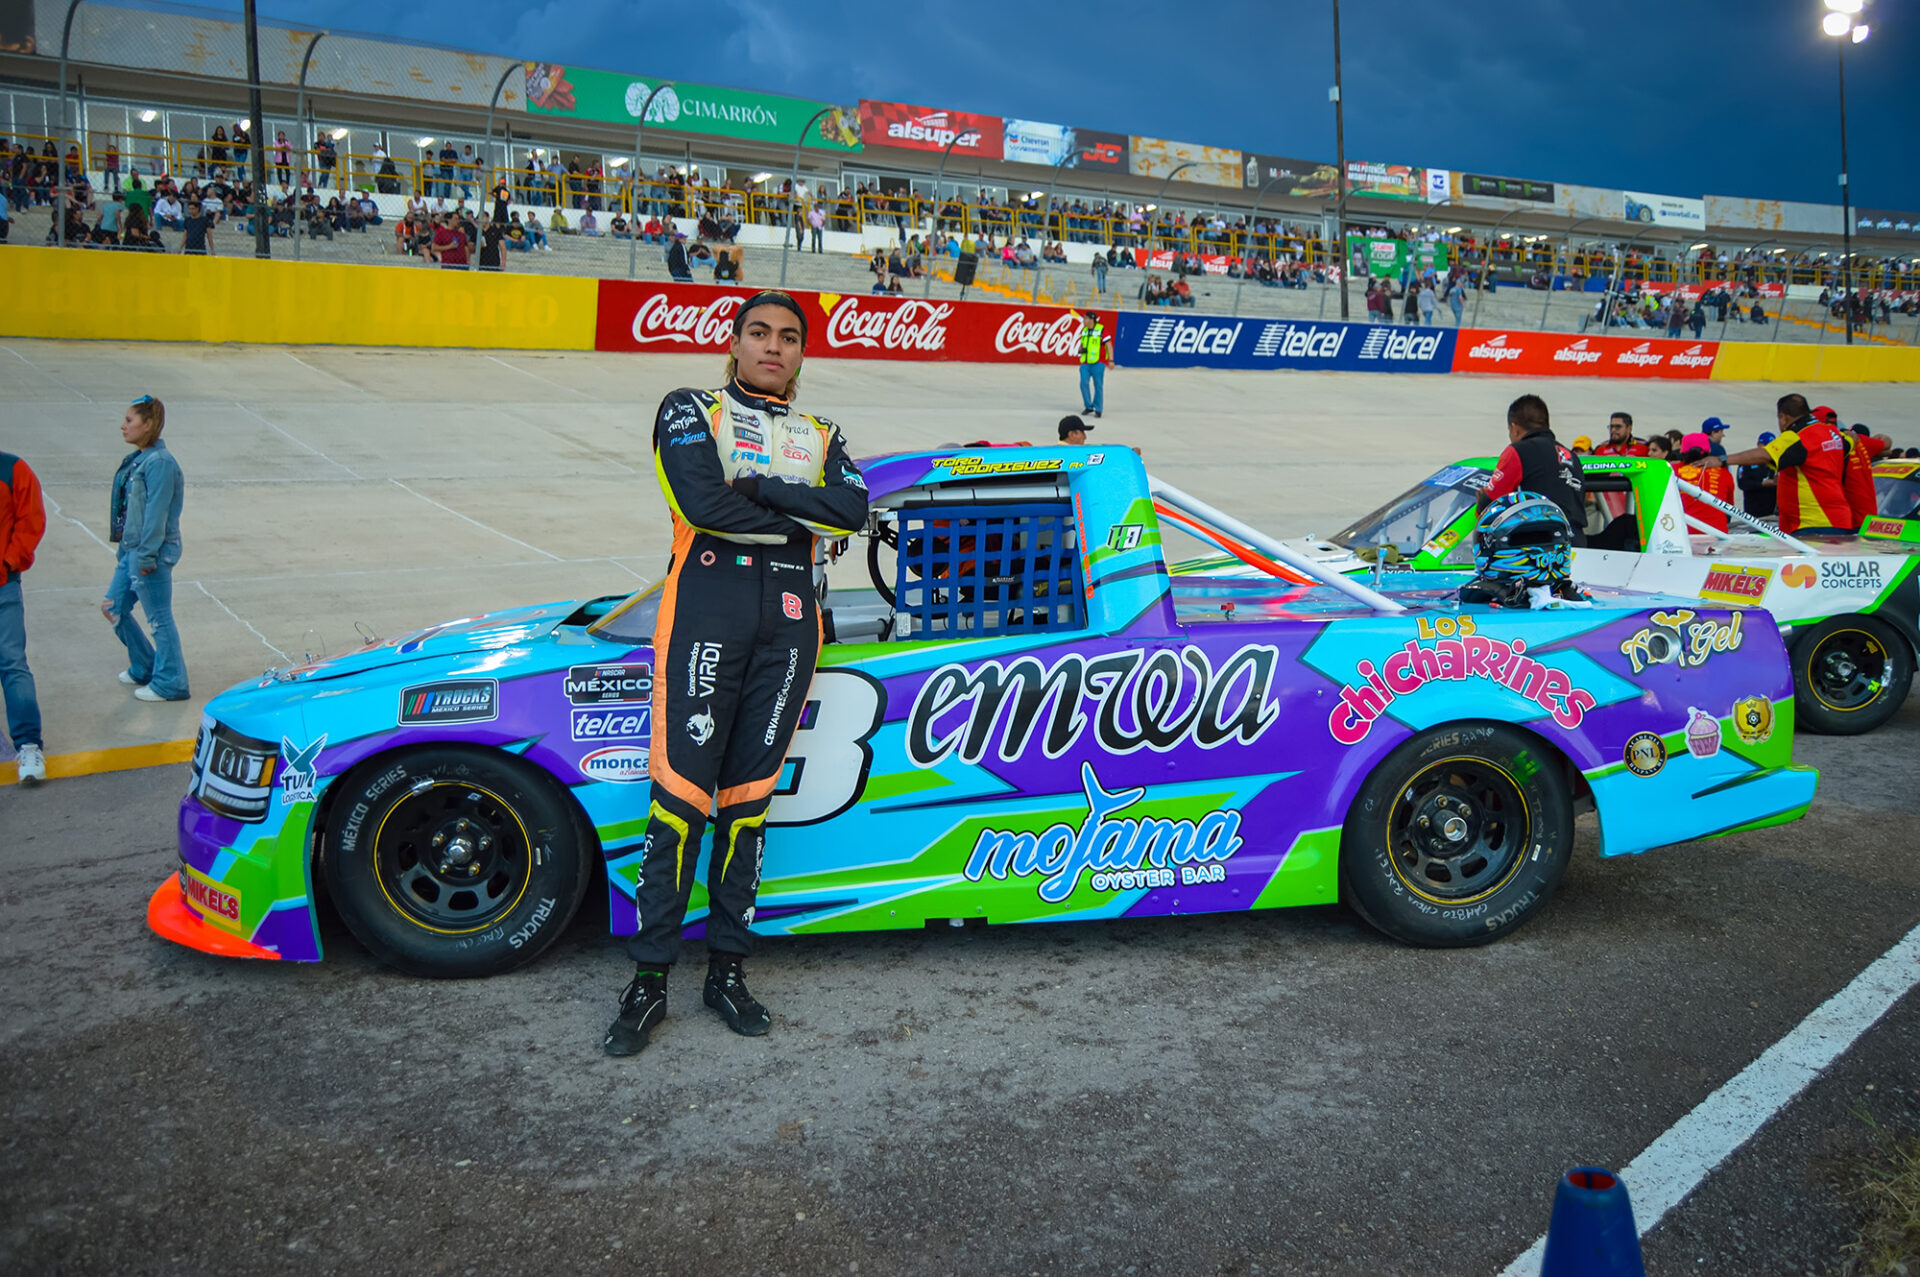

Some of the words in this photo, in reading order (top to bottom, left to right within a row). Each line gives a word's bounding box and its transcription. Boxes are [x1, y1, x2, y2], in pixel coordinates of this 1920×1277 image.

[682, 99, 778, 126] CIMARRÓN
[887, 120, 982, 147] alsuper
[632, 292, 735, 345] Coca-Co
[826, 296, 954, 352] Coca-Cola
[995, 310, 1083, 357] Coca-Col
[1168, 320, 1243, 355] telcel
[1279, 326, 1348, 358] telcel
[1382, 329, 1443, 361] telcel
[1469, 344, 1522, 362] alsuper
[1553, 347, 1602, 365] alsuper
[1616, 350, 1663, 367] alsuper
[1669, 351, 1714, 368] alsuper
[932, 456, 984, 468] TORO
[950, 459, 1064, 476] RODRIGUEZ
[1086, 453, 1106, 466] 8
[1635, 460, 1648, 469] 34
[1867, 520, 1903, 537] MIKEL'S
[1821, 560, 1881, 578] SOLAR
[1703, 571, 1767, 598] MIKEL'S
[1821, 578, 1882, 589] CONCEPTS
[781, 591, 803, 620] 8
[1415, 614, 1478, 642] LOS
[1687, 610, 1743, 666] Gel
[601, 669, 626, 677] NASCAR
[699, 642, 723, 698] VIRDI
[434, 686, 493, 706] TRUCKS
[568, 677, 653, 693] MÉXICO
[462, 704, 488, 712] SERIES
[904, 643, 1281, 770] emwa
[575, 710, 649, 736] telcel
[1632, 747, 1659, 761] PNL
[365, 765, 408, 801] SERIES
[342, 803, 369, 852] MÉXICO
[1091, 868, 1176, 892] OYSTER
[1181, 865, 1227, 885] BAR
[187, 874, 240, 922] MIKEL'S
[1485, 889, 1540, 931] TRUCKS
[508, 897, 556, 949] TRUCKS
